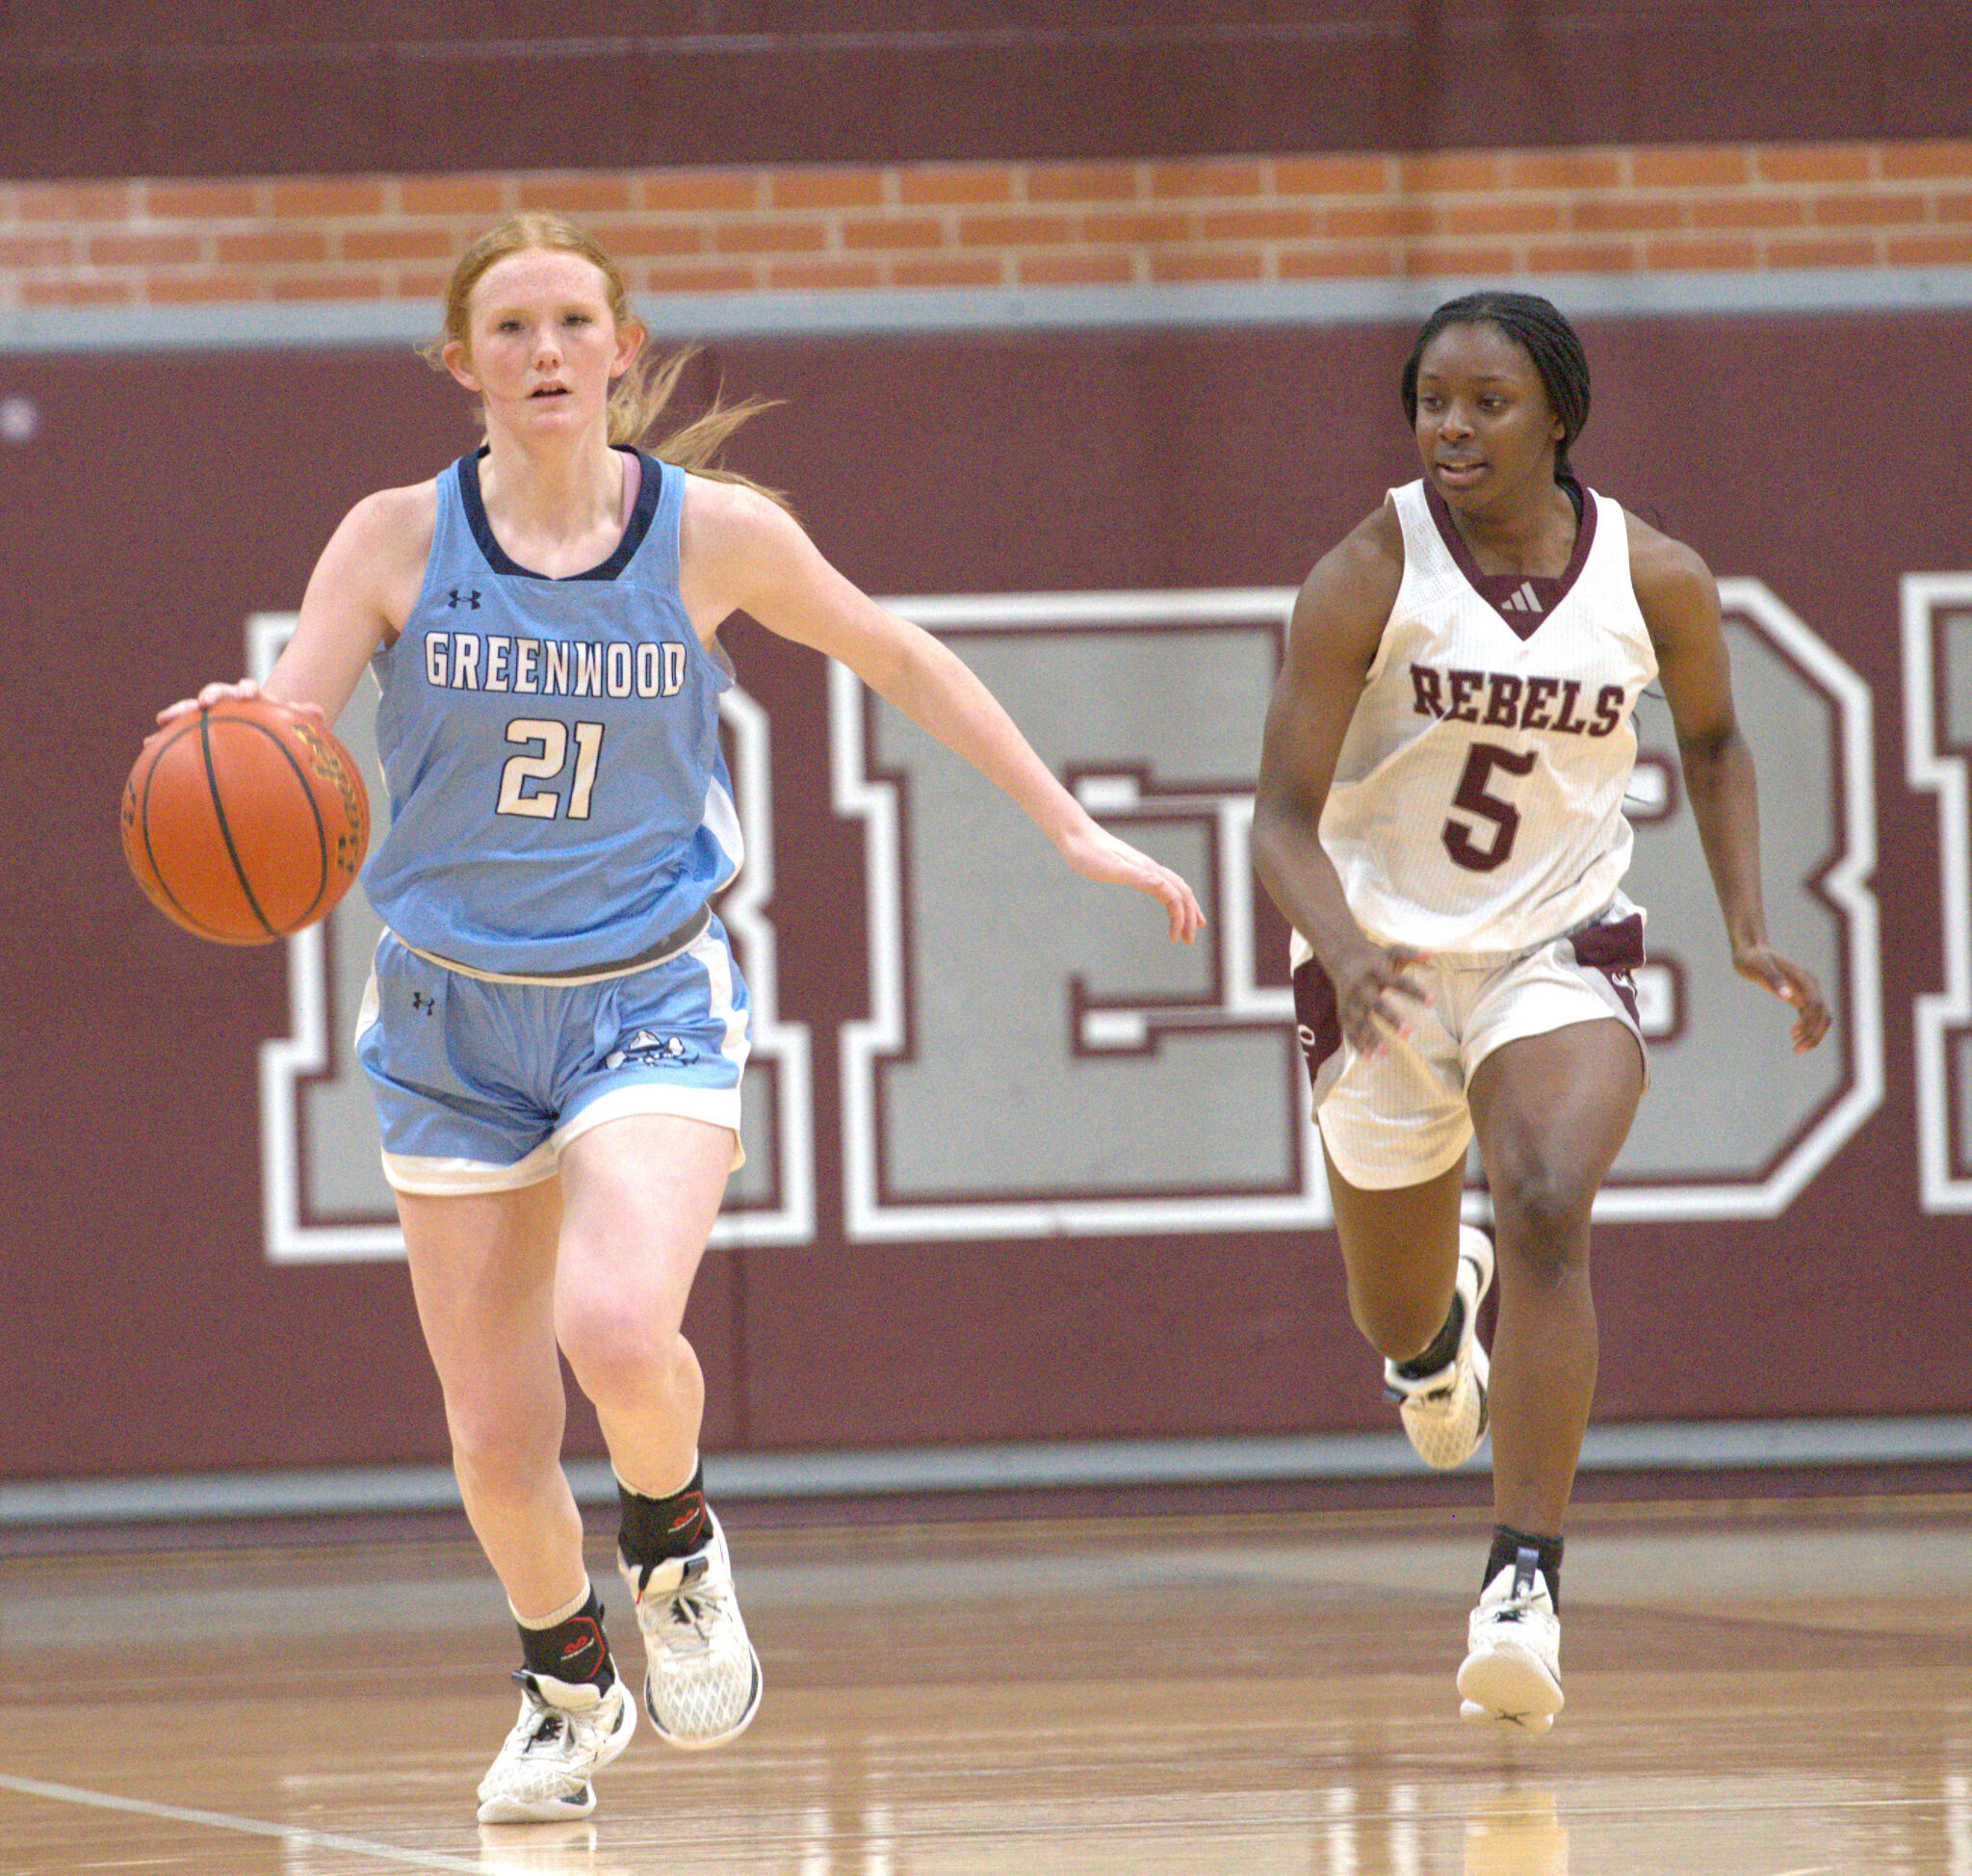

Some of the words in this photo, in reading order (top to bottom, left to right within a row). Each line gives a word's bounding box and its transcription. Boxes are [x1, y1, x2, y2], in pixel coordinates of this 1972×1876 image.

[425, 630, 688, 699] GREENWOOD
[1410, 661, 1625, 739] REBELS
[494, 717, 606, 821] 21
[1441, 743, 1538, 873] 5
